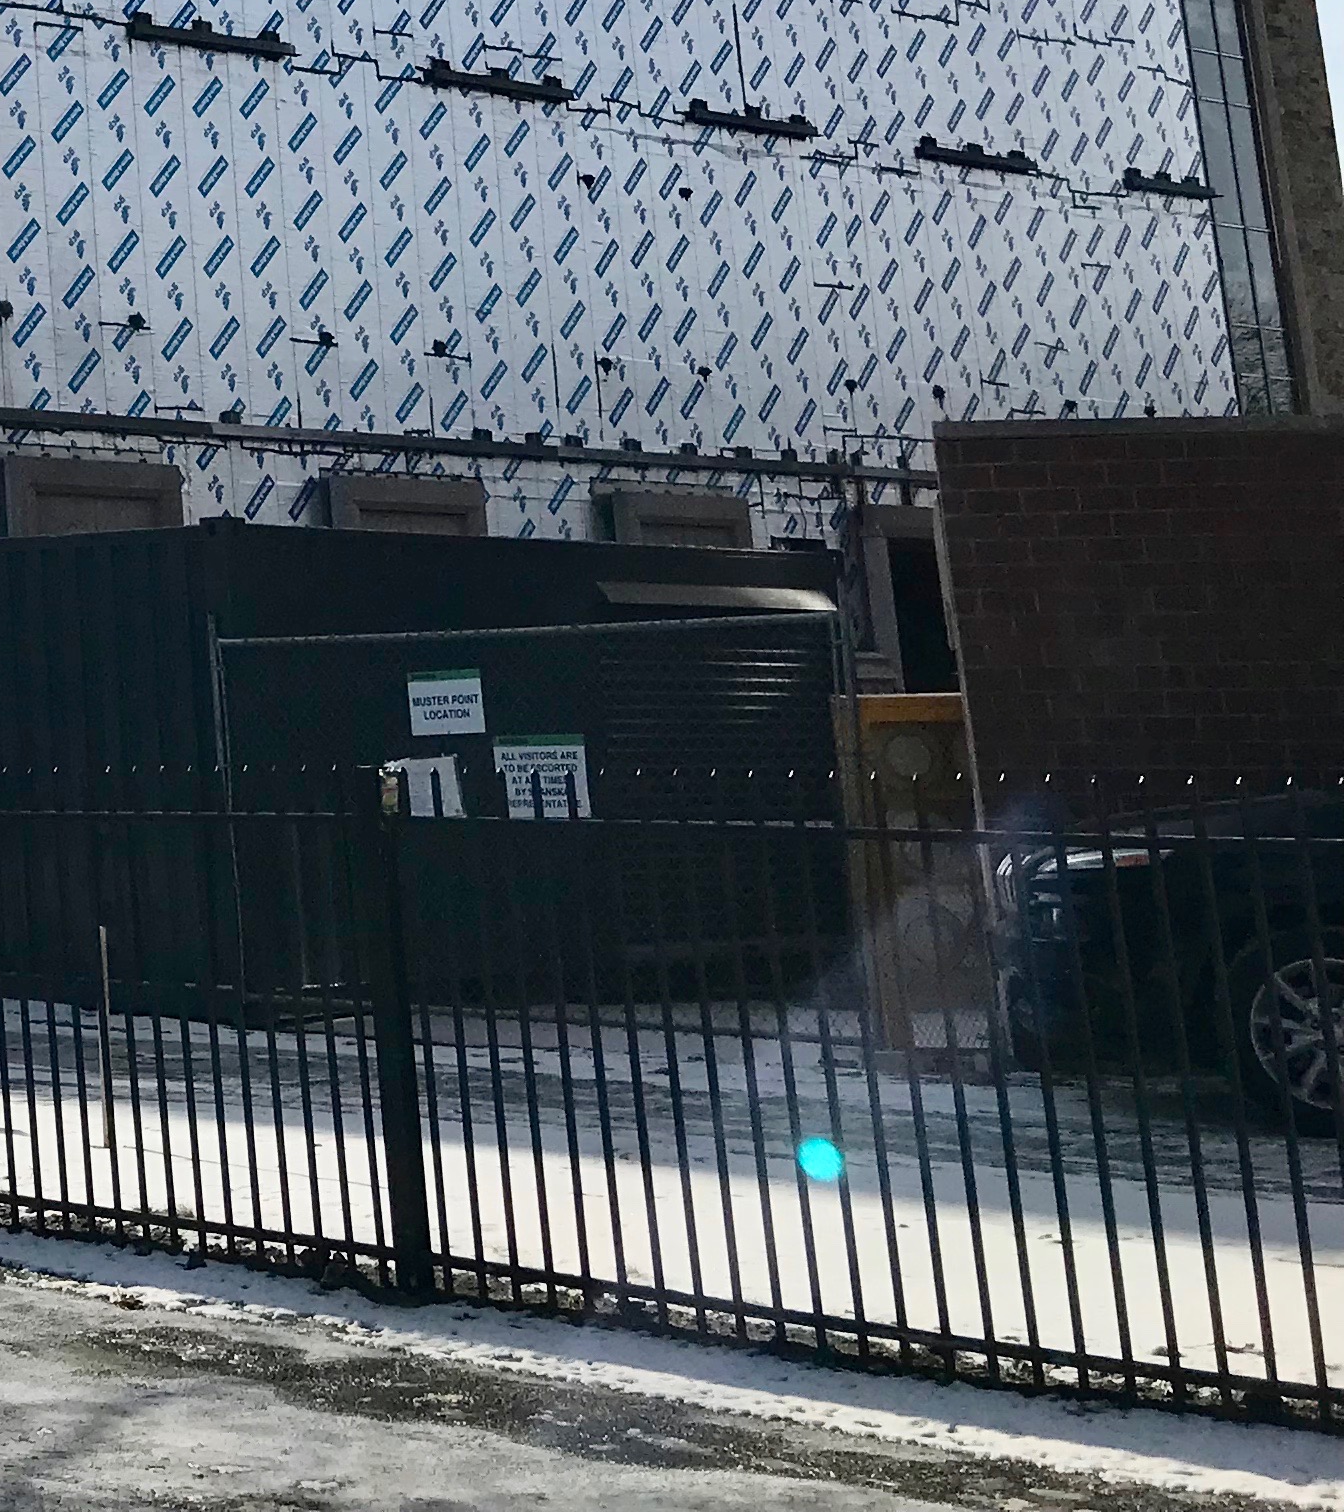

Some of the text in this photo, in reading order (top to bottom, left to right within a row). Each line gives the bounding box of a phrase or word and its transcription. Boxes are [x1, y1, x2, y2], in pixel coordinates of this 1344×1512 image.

[412, 694, 479, 706] MUSTER POINT
[423, 708, 470, 720] LOCATION
[501, 751, 578, 761] ALL VISITORS ARE
[503, 764, 515, 773] TO
